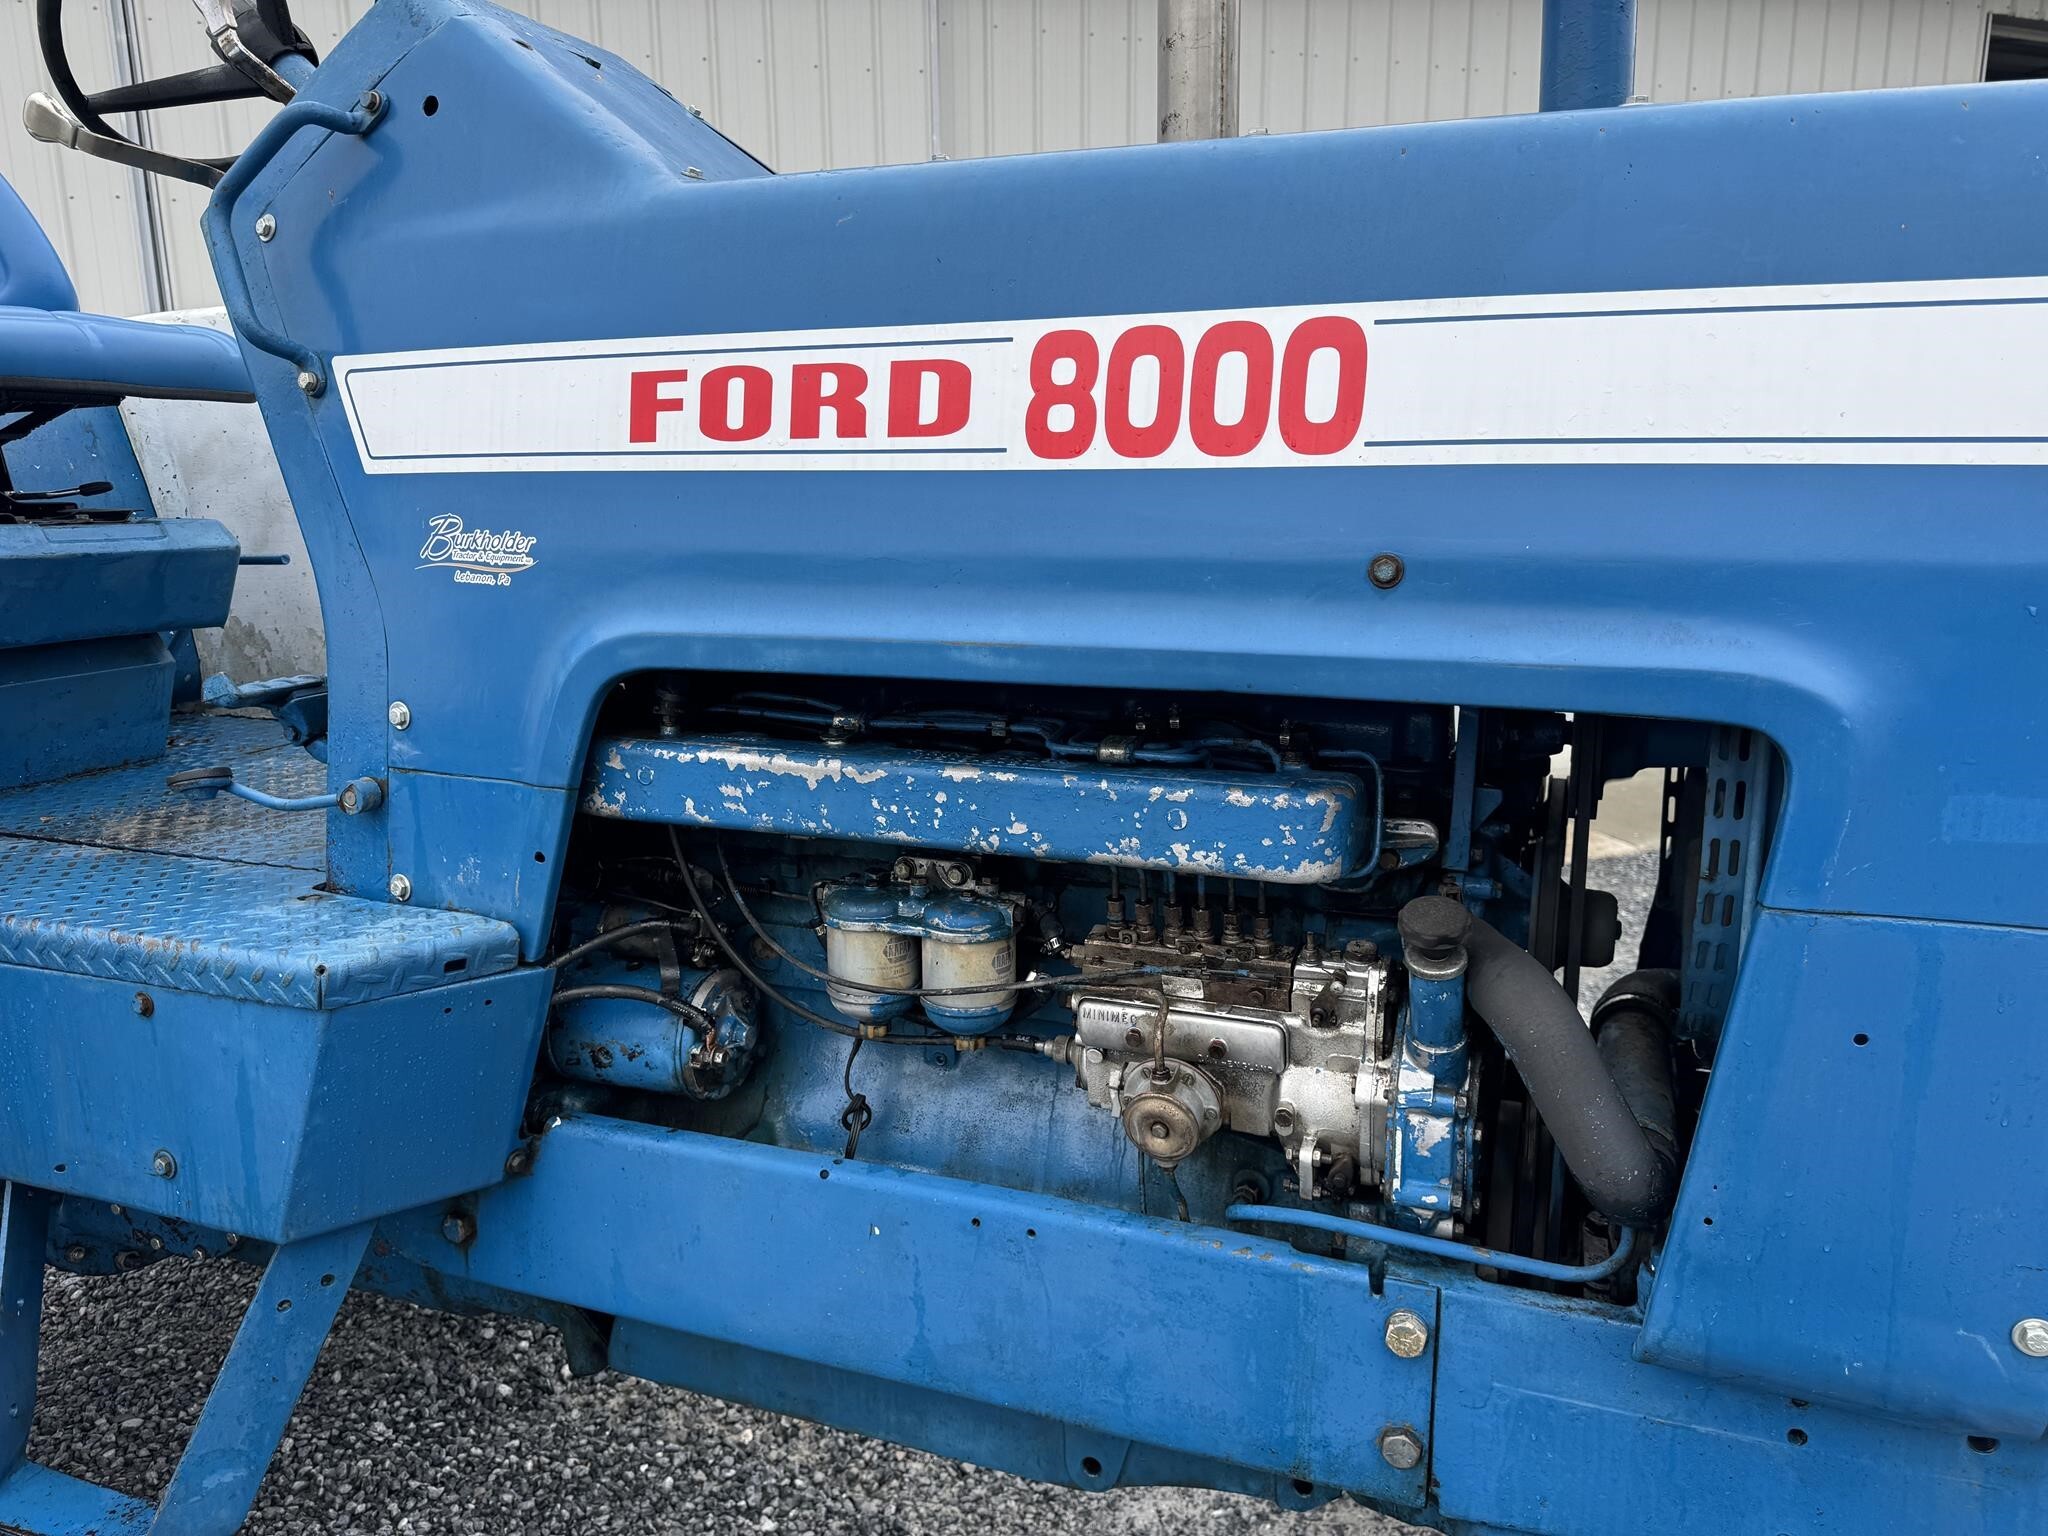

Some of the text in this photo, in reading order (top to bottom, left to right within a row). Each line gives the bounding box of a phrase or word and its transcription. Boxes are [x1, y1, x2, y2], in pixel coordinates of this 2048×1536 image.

[629, 316, 1368, 459] FORD 8000
[420, 513, 537, 561] Burkholder
[452, 550, 477, 561] Tractor
[478, 552, 484, 561] &
[486, 552, 525, 565] Equipment
[454, 571, 511, 586] Lebanon, Pa
